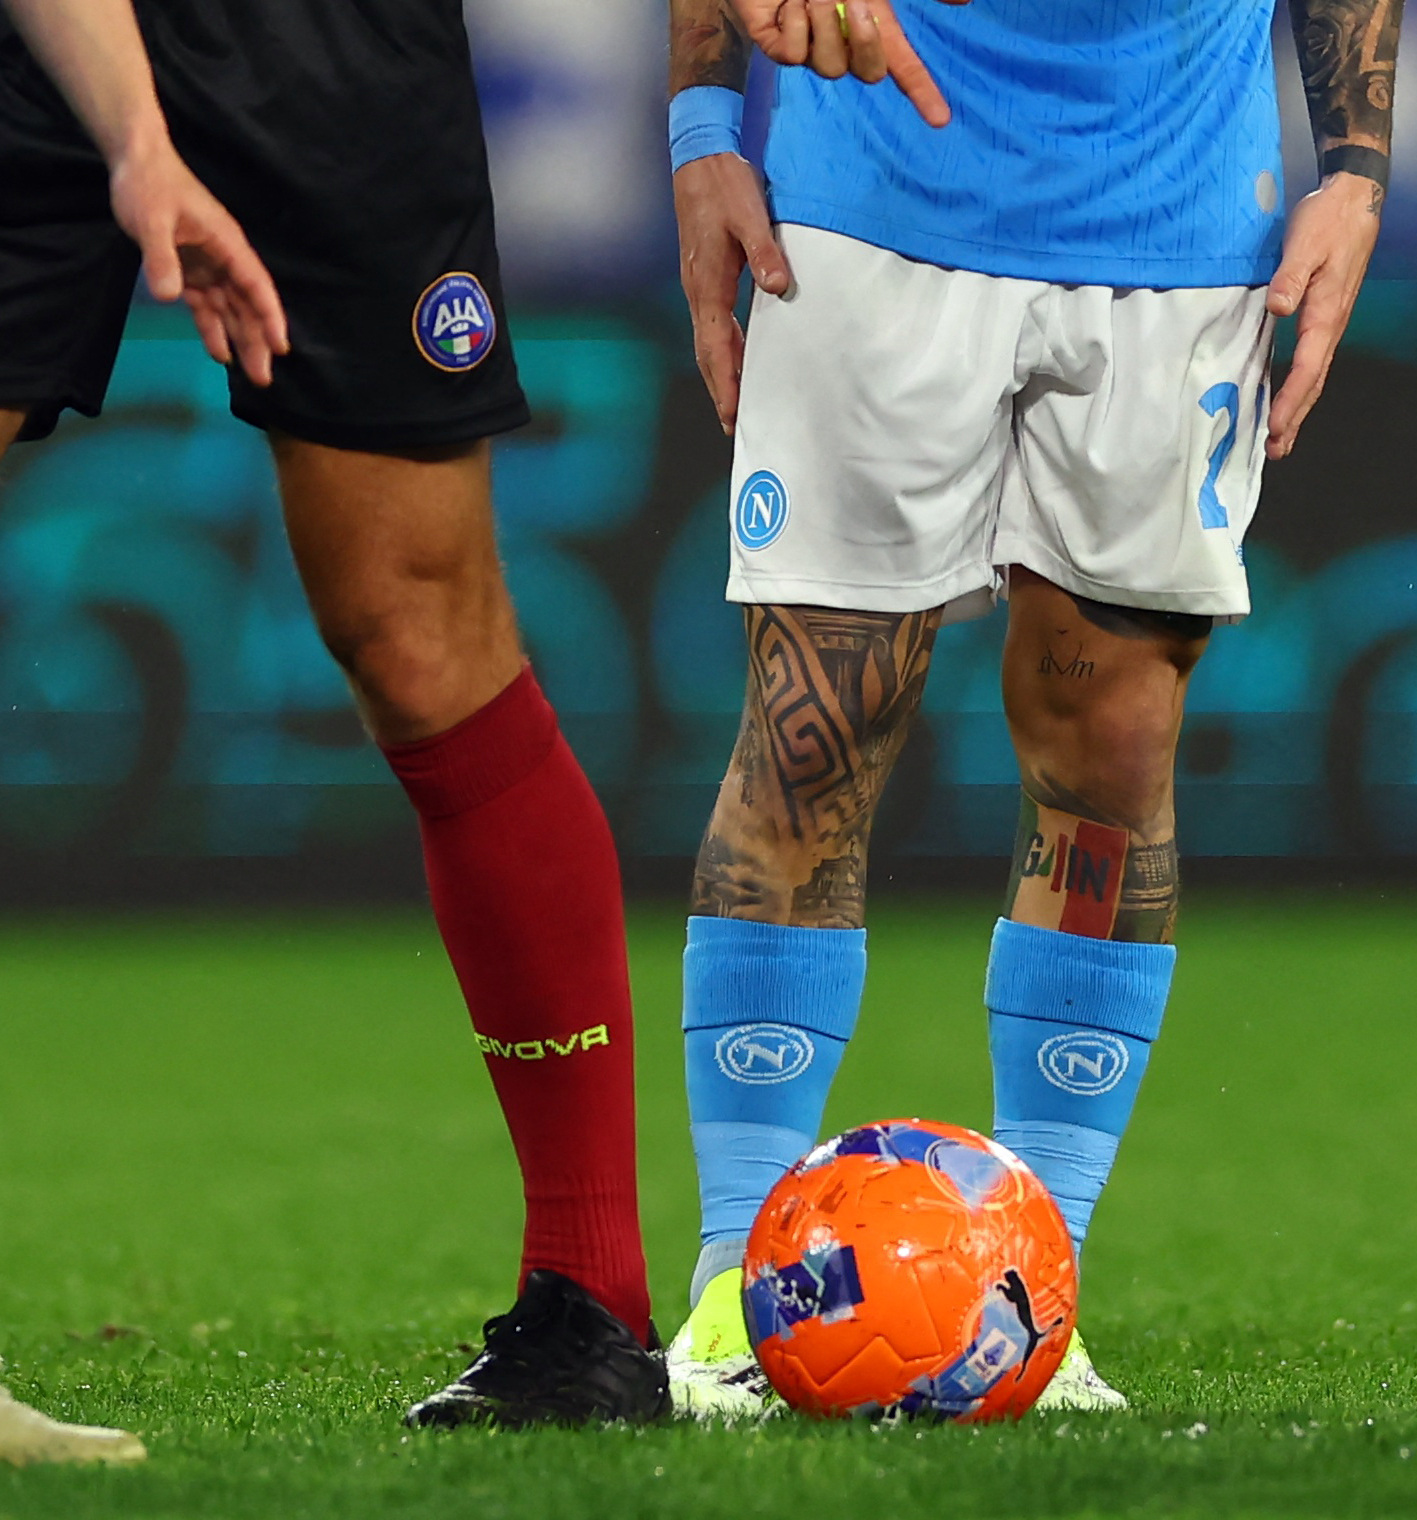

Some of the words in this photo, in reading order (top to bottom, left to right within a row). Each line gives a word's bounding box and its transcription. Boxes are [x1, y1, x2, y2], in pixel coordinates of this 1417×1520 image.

[432, 296, 485, 338] AIA
[748, 490, 778, 530] N
[473, 1023, 610, 1061] GIVOVA
[740, 1041, 790, 1072] N
[1063, 1049, 1107, 1081] N
